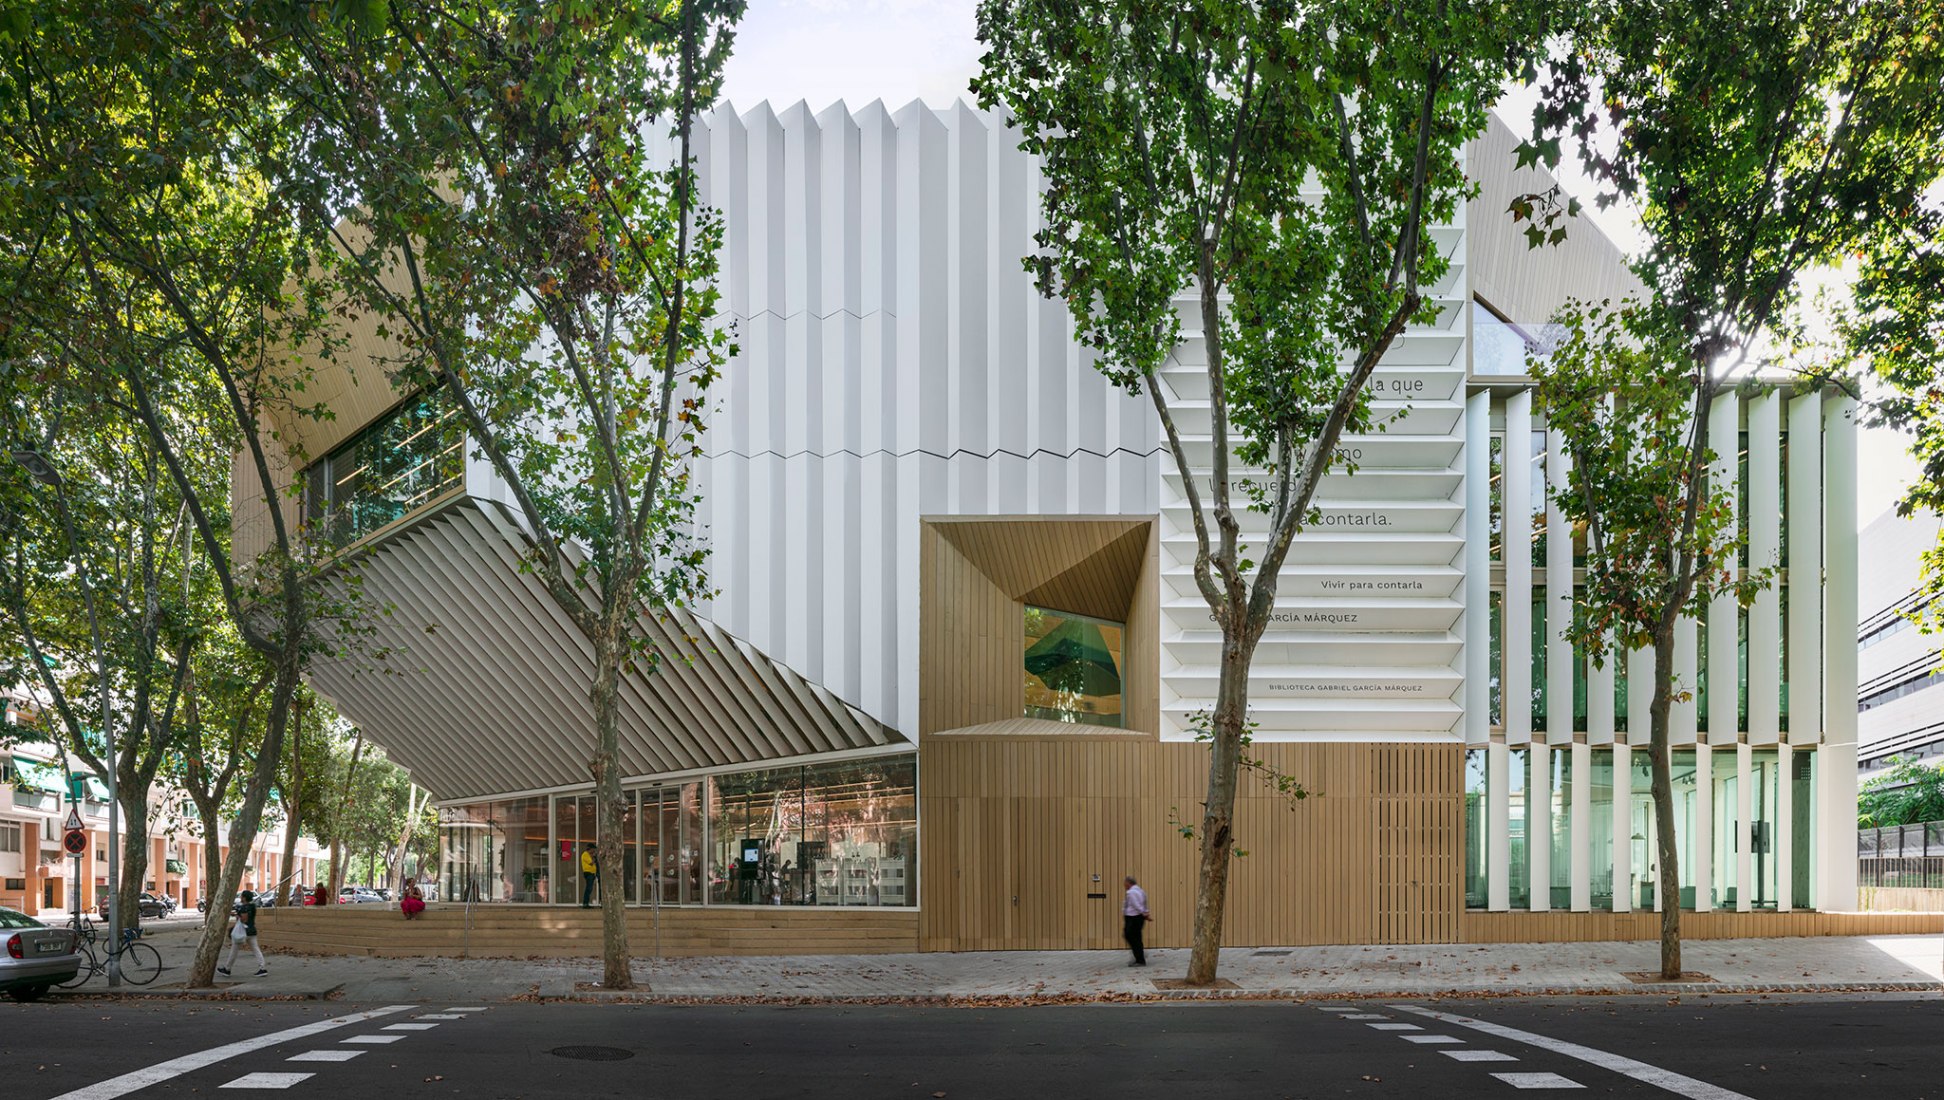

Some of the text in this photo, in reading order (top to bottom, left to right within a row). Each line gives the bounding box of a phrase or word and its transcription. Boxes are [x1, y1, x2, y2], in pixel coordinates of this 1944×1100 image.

[1370, 375, 1423, 395] la que
[1320, 580, 1423, 592] Vivir para contarla
[1267, 612, 1359, 624] ARCÍA MÁRQUEZ
[1317, 684, 1351, 692] GABRIEL
[1352, 683, 1382, 692] GARCÍA
[1384, 684, 1423, 693] MÁRQUEZ
